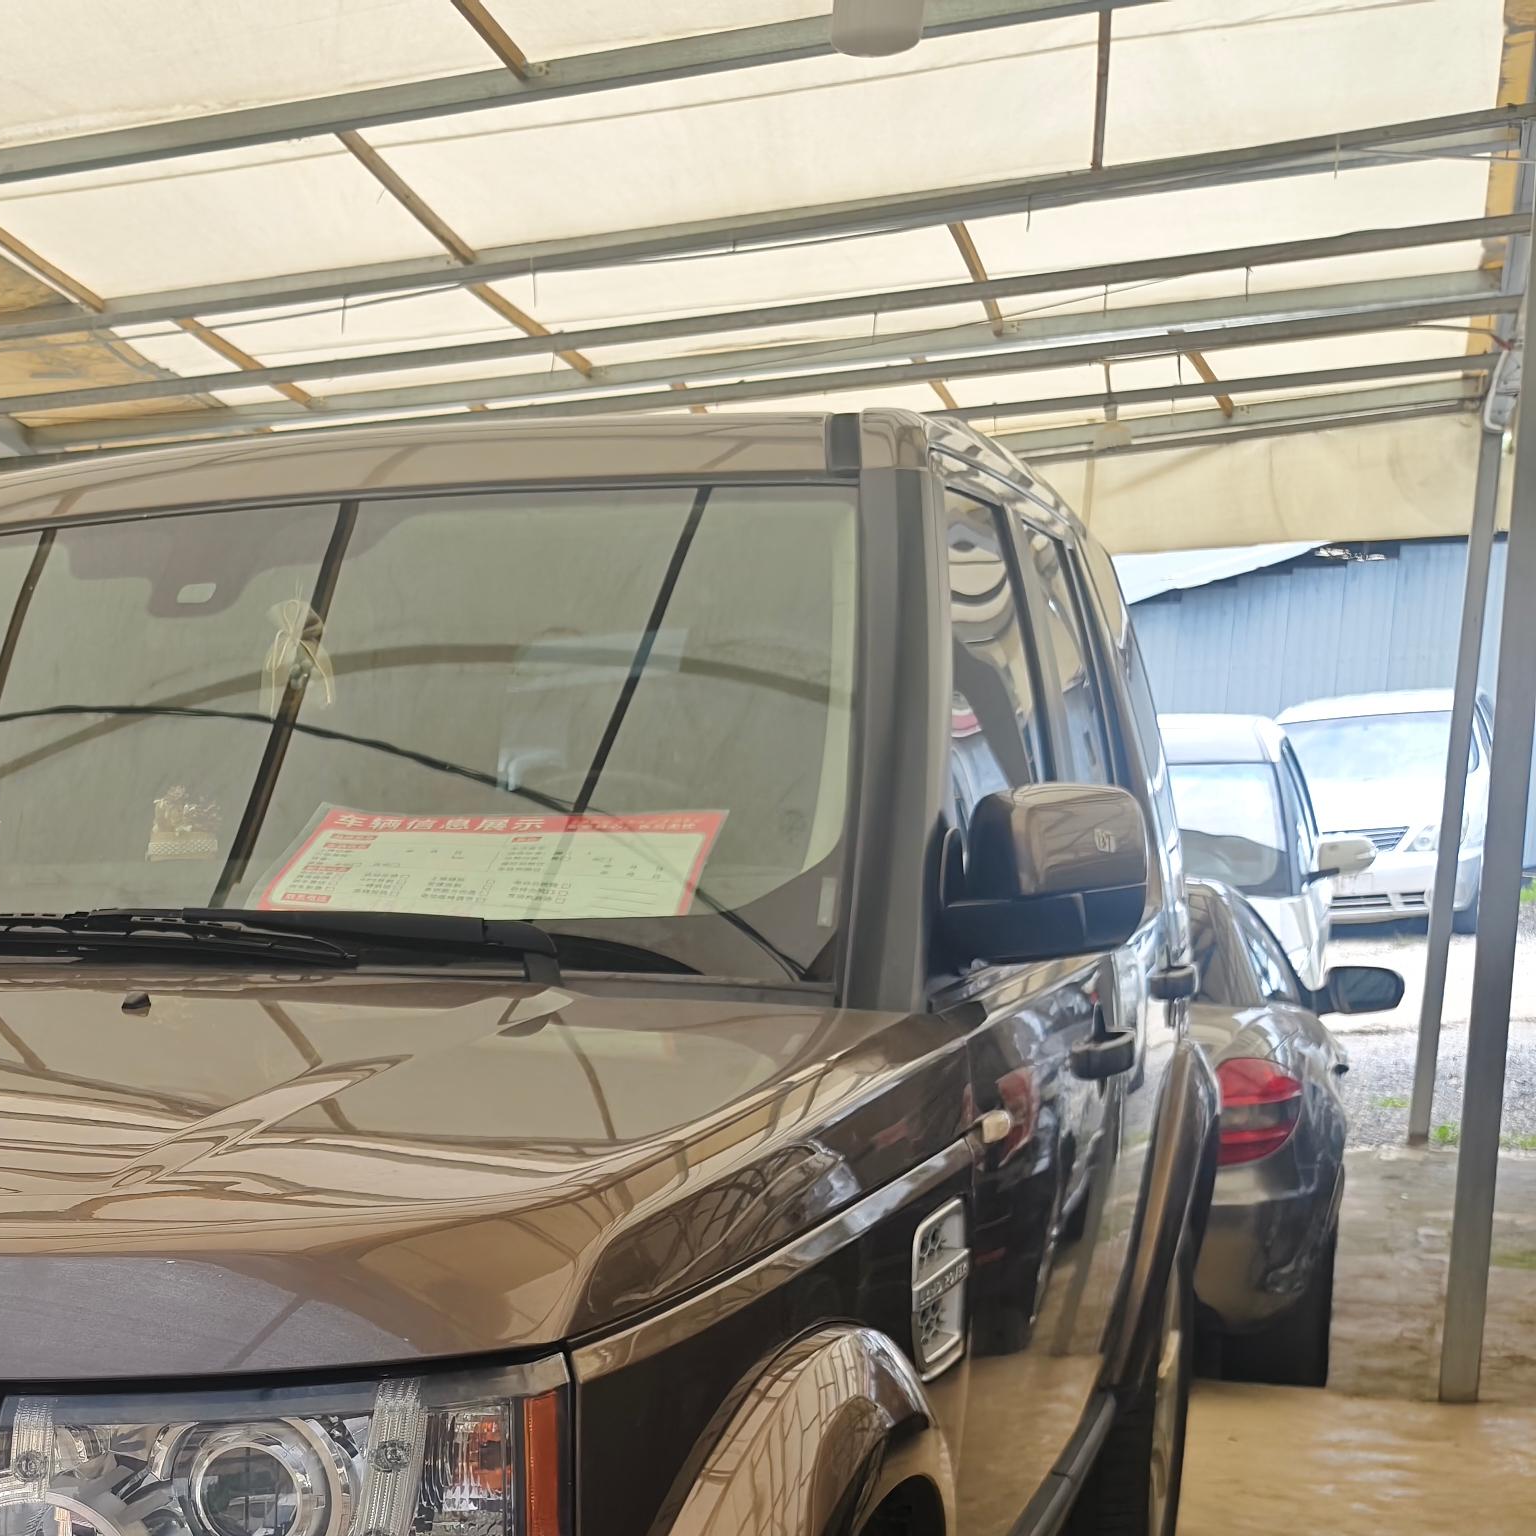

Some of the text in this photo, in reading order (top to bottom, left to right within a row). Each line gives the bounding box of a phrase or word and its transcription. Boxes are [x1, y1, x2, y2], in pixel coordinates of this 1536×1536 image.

[334, 814, 546, 831] 车辆信息展示
